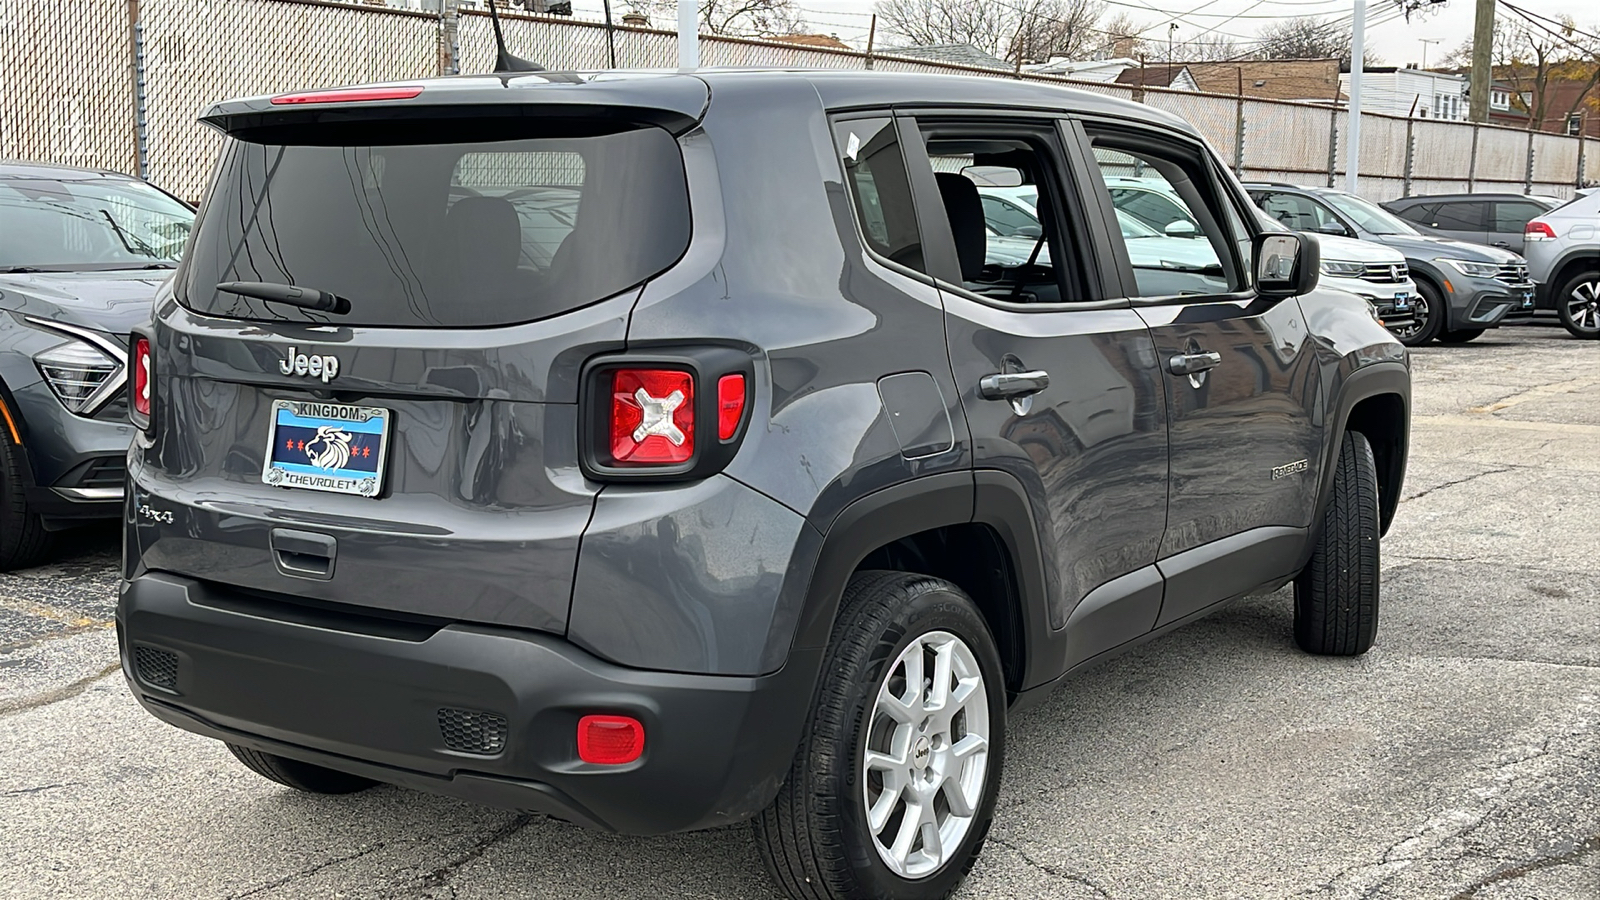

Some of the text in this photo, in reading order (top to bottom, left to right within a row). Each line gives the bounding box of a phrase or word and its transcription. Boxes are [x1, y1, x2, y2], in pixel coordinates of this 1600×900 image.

[279, 346, 339, 383] Jeep
[300, 404, 360, 420] KINGDOM
[1271, 458, 1308, 480] RENEGADE
[289, 474, 351, 490] CHEVROLET
[915, 747, 930, 759] Jeep
